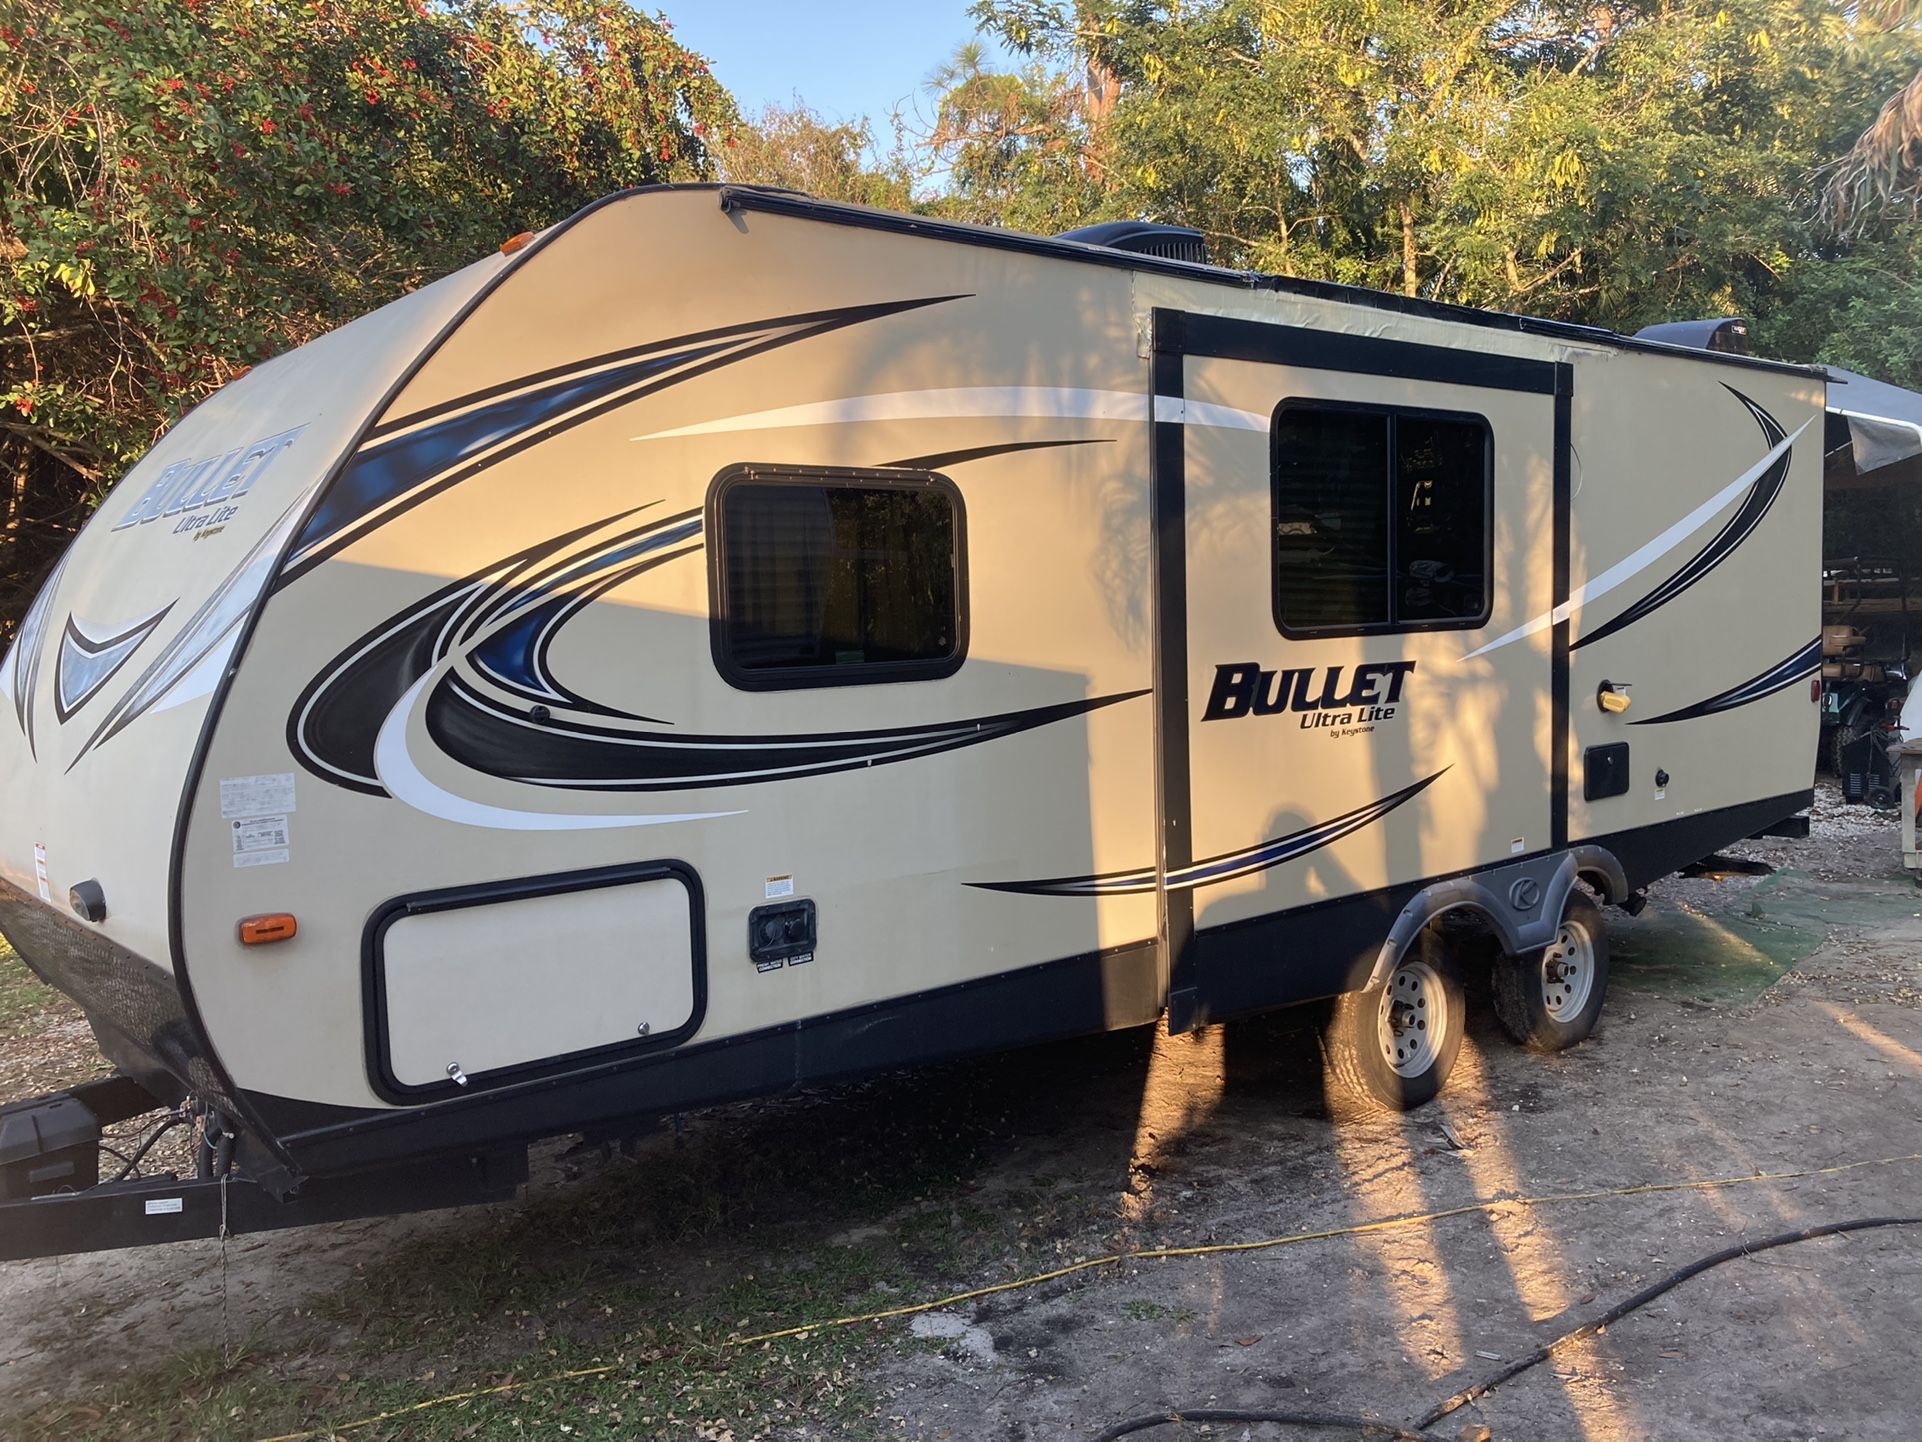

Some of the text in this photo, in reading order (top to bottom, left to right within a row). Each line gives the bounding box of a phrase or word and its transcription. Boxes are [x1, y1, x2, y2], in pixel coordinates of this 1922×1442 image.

[111, 422, 312, 532] BULLET
[172, 506, 239, 534] Ultra Lite
[1200, 660, 1416, 722] BULLET
[1300, 706, 1395, 729] Ultra Lite
[1330, 726, 1375, 738] by Keystone
